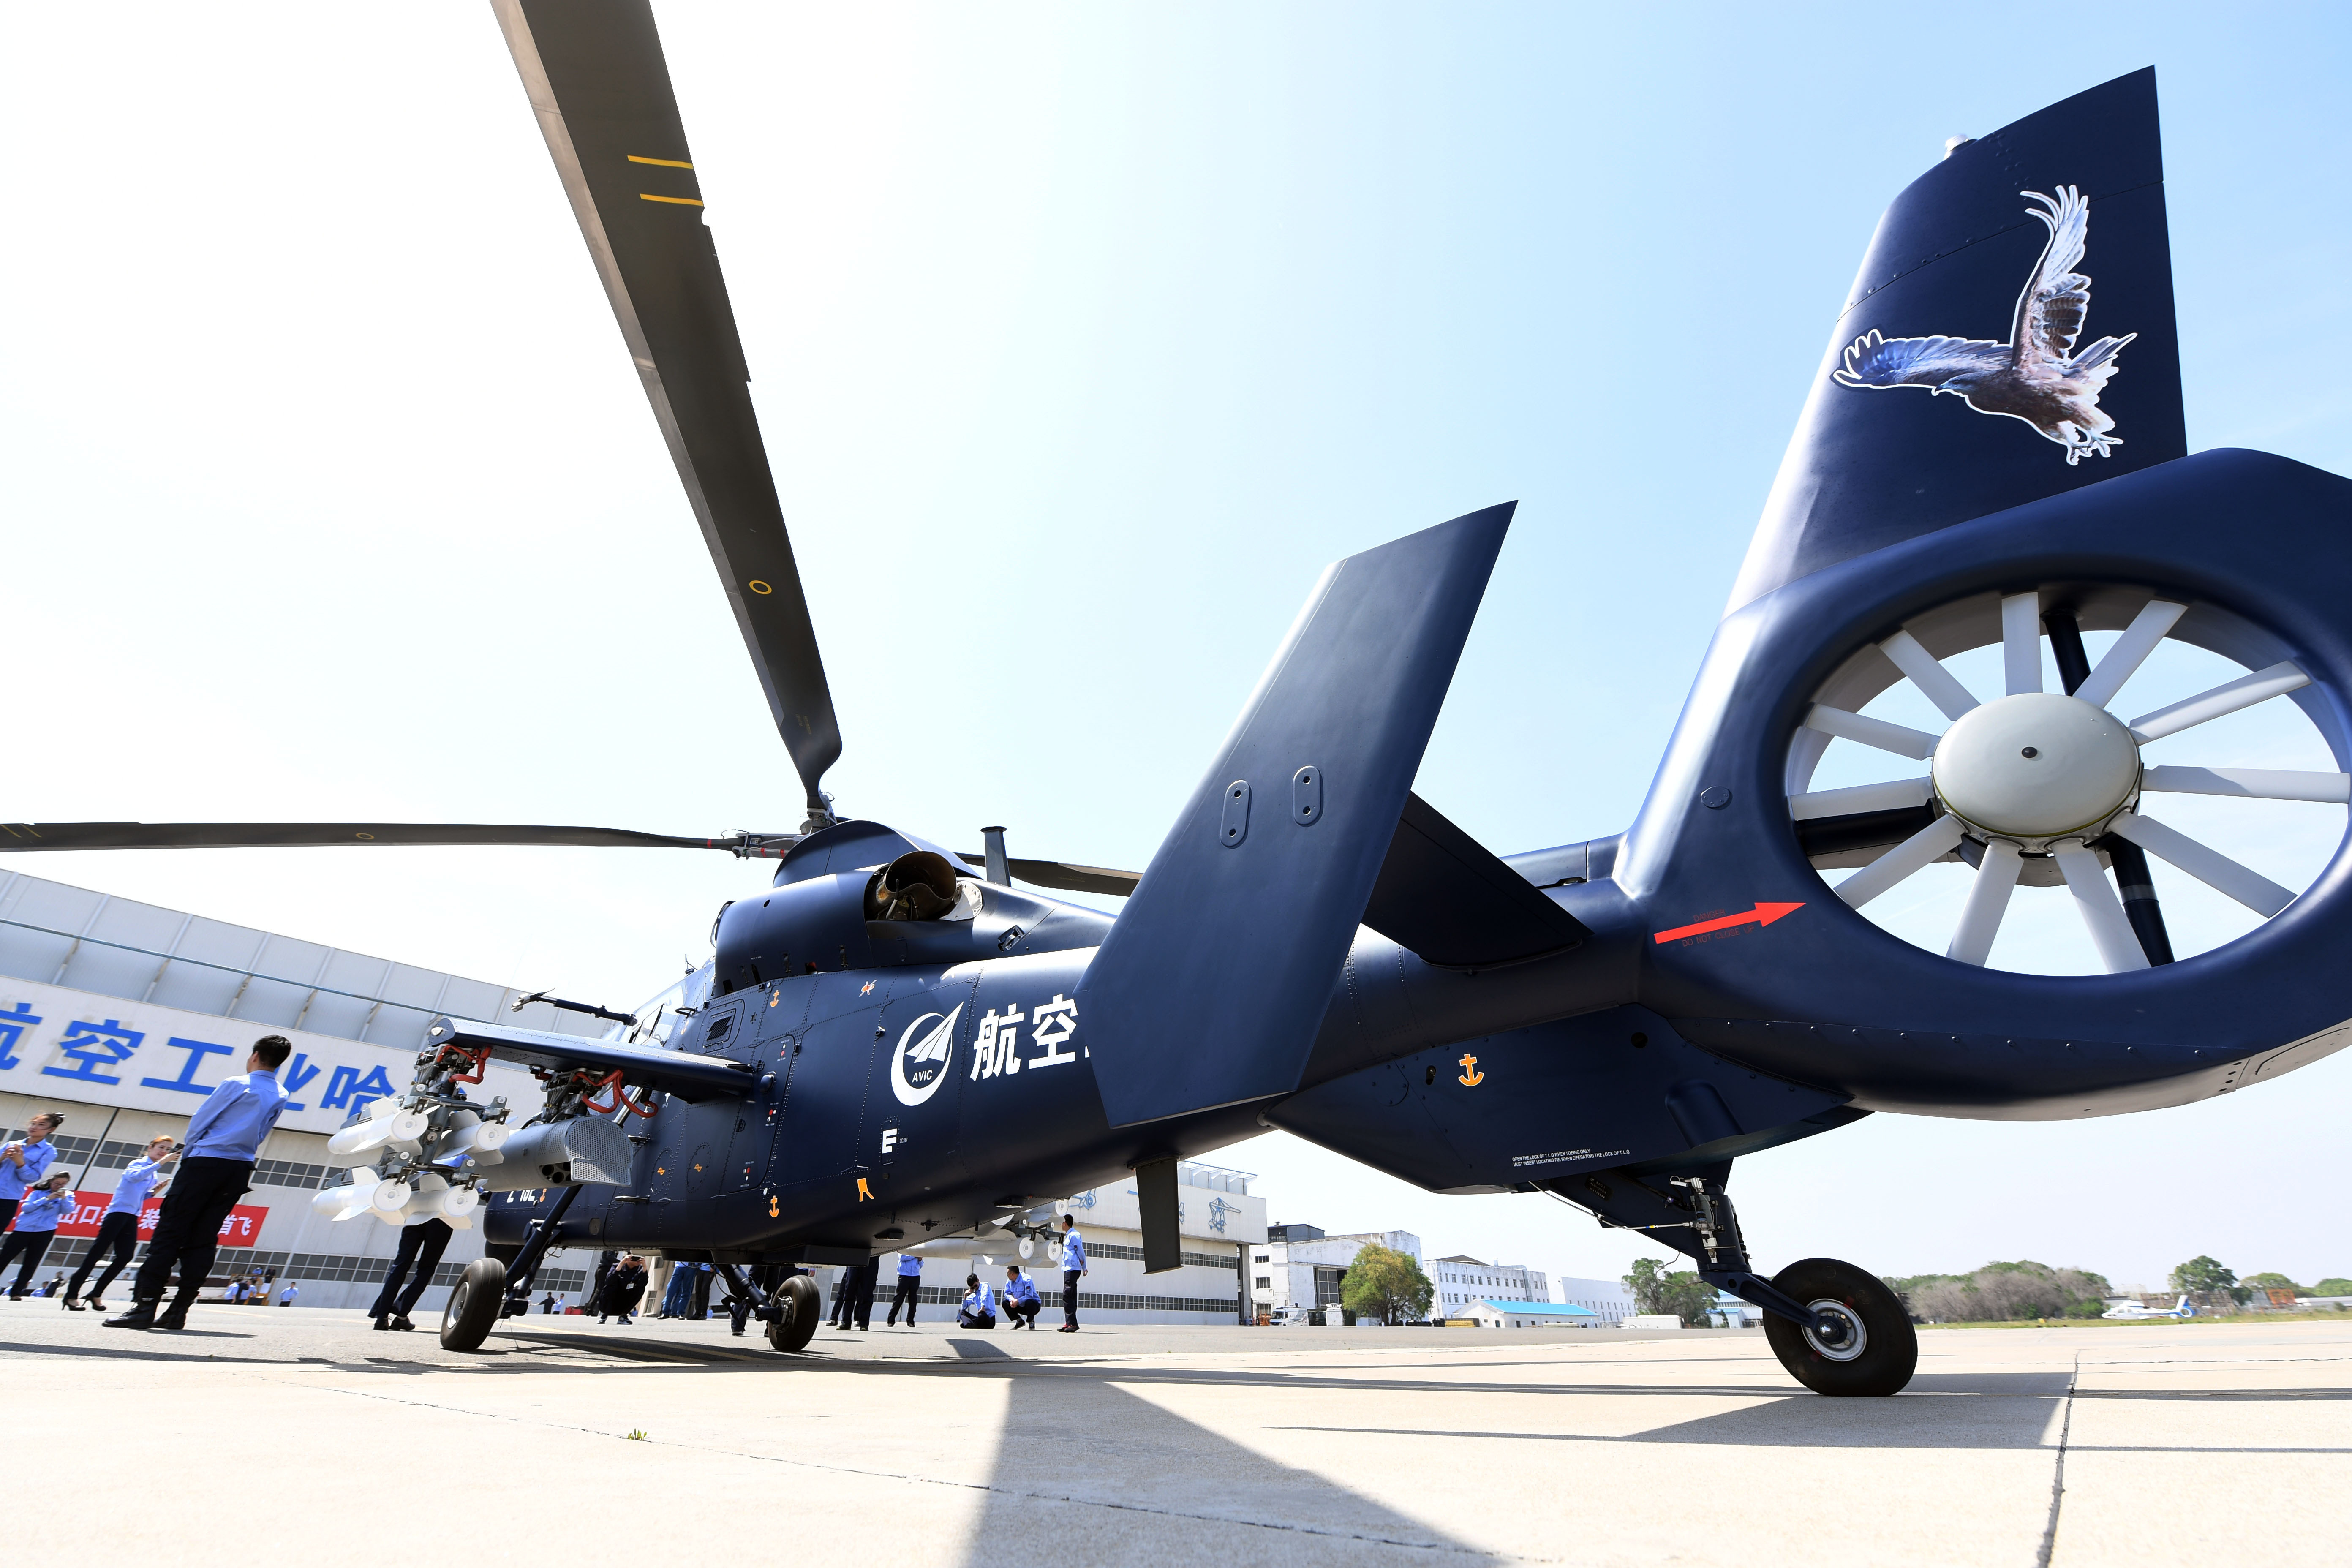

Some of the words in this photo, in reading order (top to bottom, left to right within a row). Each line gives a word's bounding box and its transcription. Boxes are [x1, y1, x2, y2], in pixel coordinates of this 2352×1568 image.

[1693, 909, 1726, 922] DANGER
[1682, 938, 1693, 947] DO
[1696, 934, 1711, 944] NOT
[969, 994, 1090, 1081] 航空
[912, 1070, 933, 1083] AVIC
